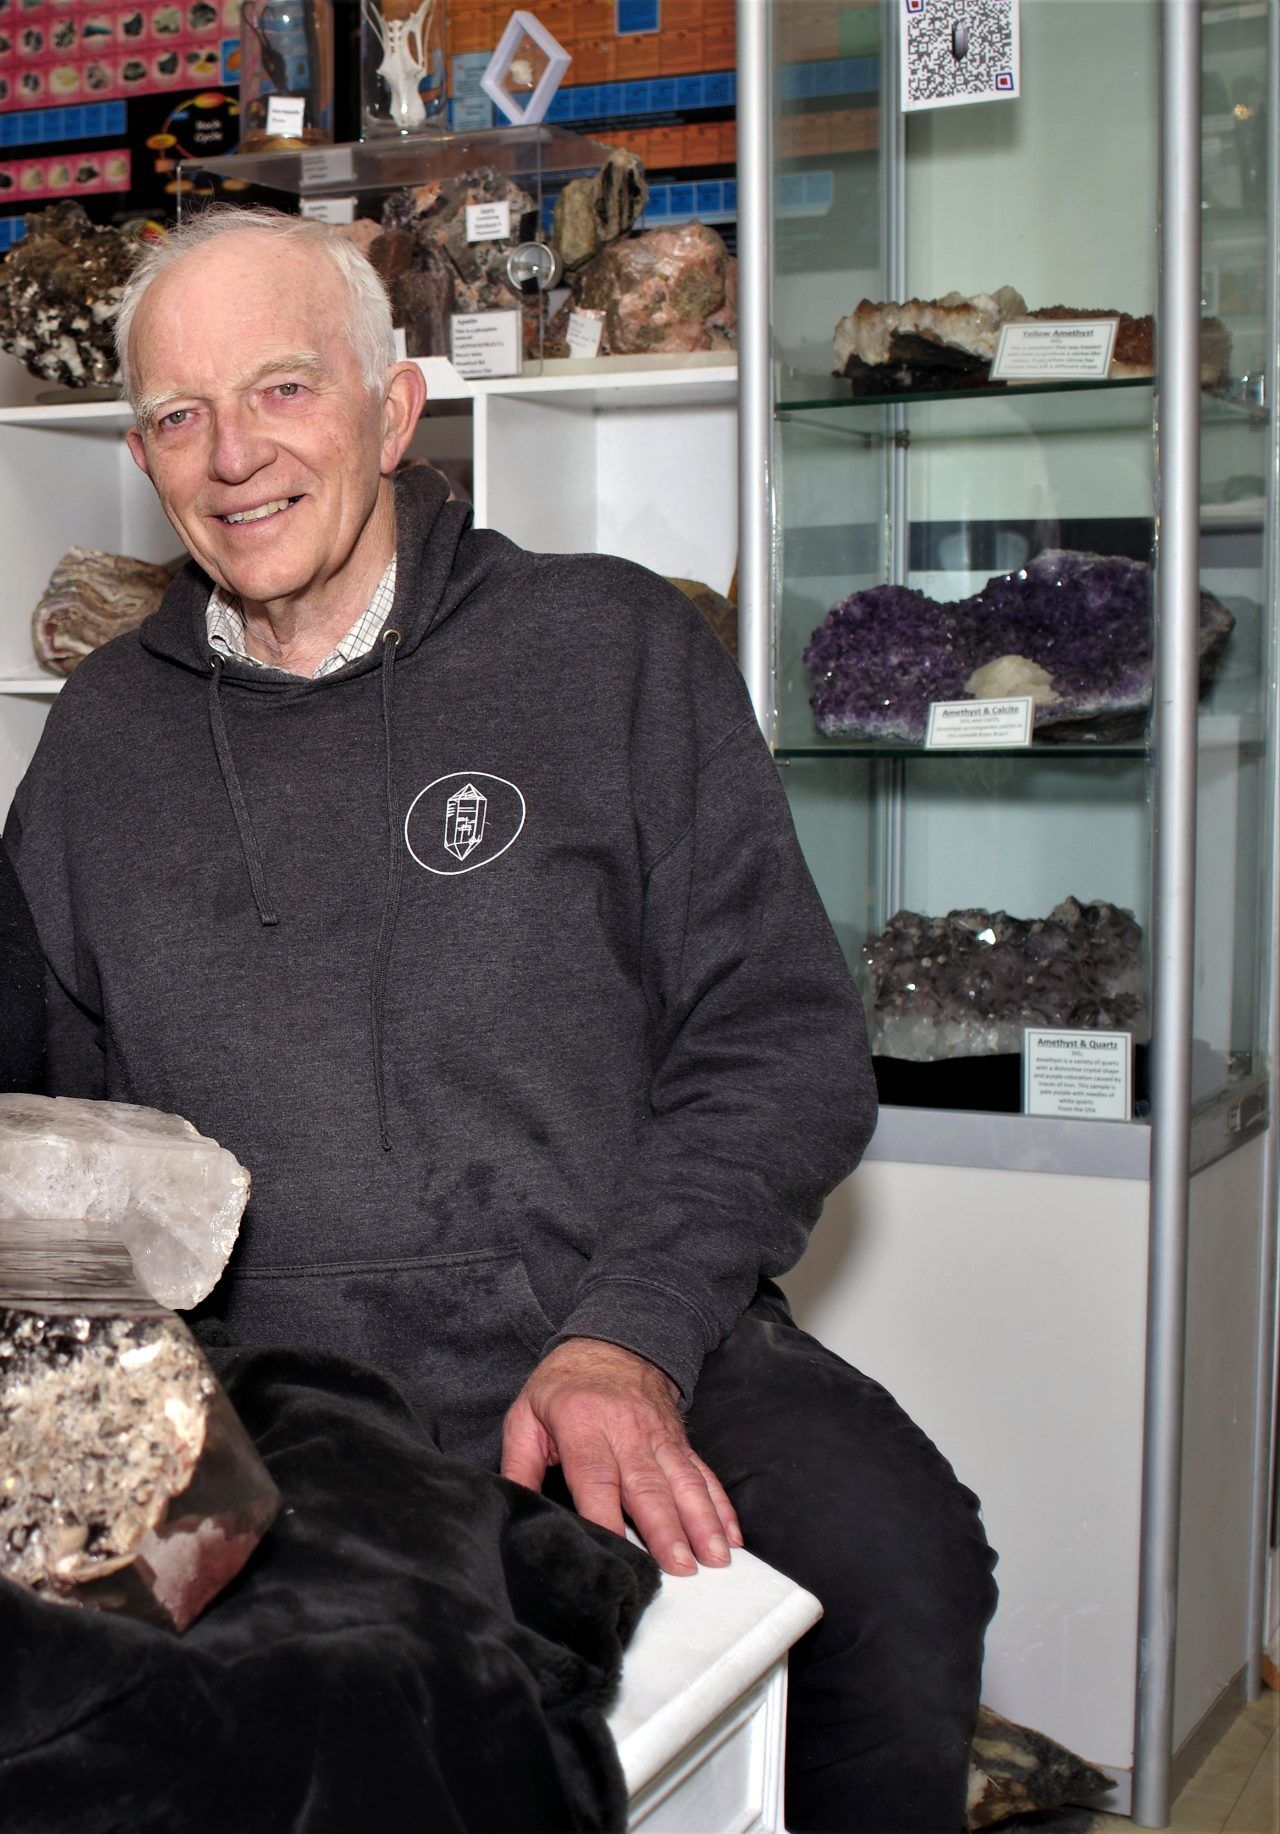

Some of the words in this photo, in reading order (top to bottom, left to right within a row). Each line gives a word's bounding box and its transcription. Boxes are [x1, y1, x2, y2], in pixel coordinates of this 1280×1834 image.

[1052, 329, 1094, 338] Amethyst
[942, 708, 981, 717] Amethyst
[992, 706, 1019, 714] Calcite
[1037, 1038, 1078, 1049] Amethyst
[1080, 1040, 1087, 1048] &
[1089, 1040, 1118, 1050] Quartz
